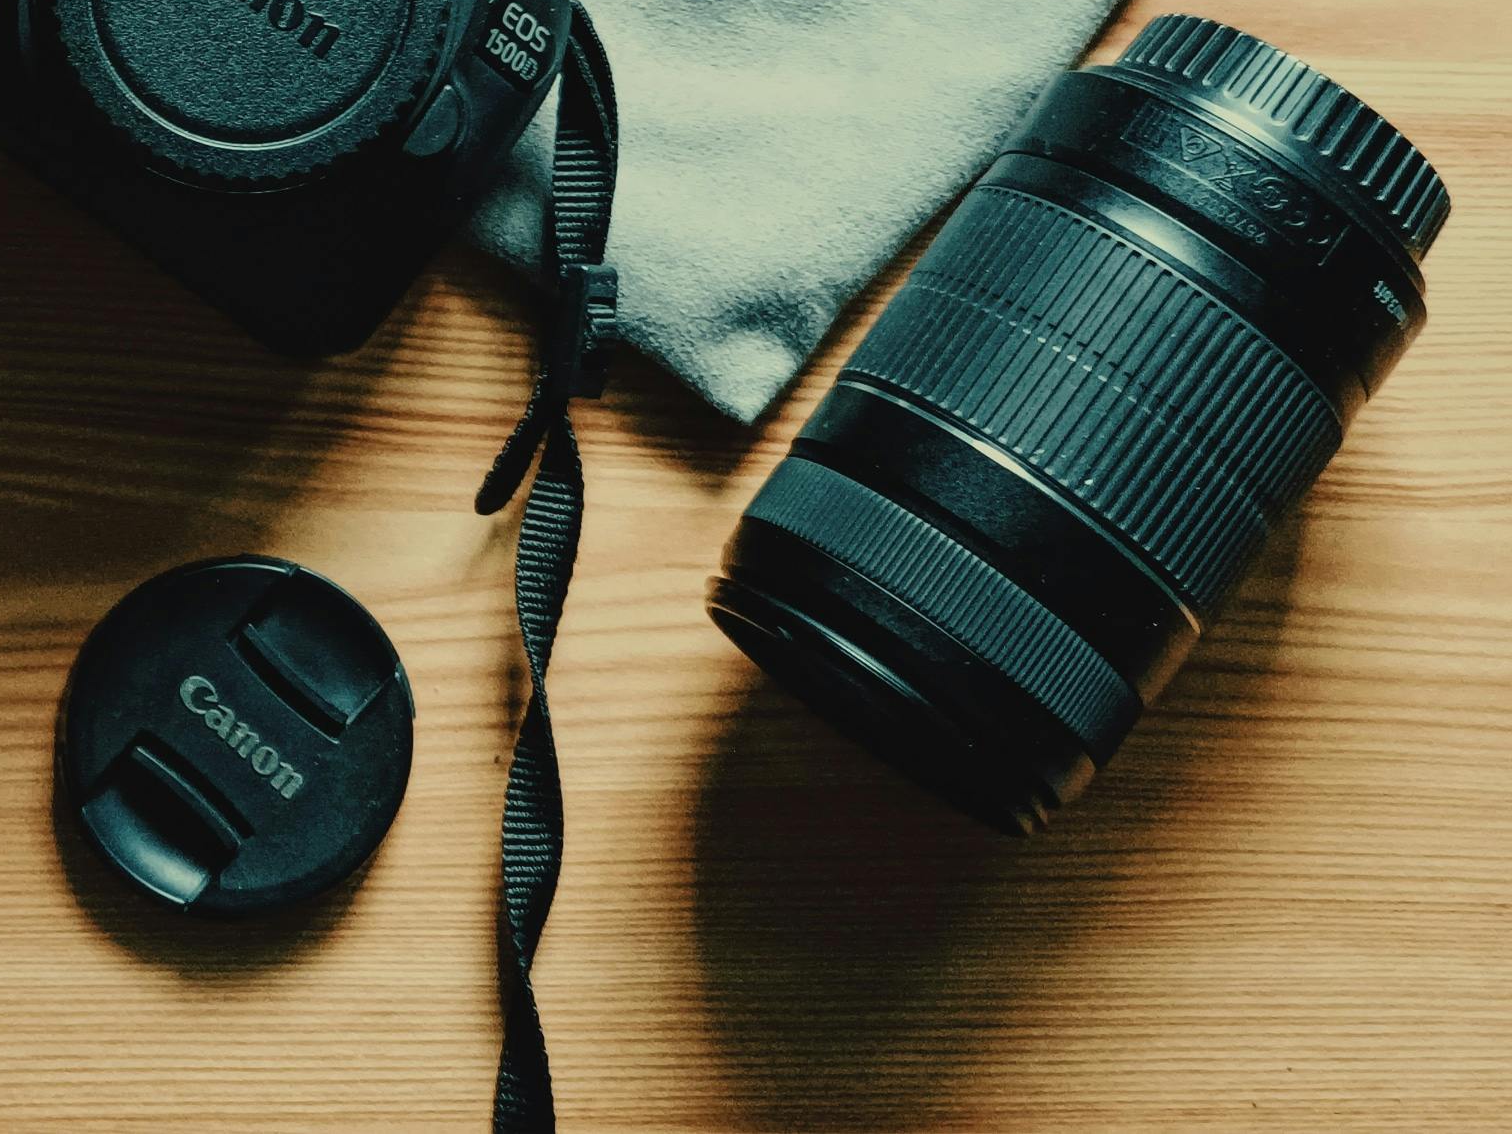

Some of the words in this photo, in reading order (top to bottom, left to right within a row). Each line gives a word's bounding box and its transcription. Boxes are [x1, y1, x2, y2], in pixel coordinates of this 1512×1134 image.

[502, 2, 551, 53] EOS
[485, 28, 538, 81] 1500D
[179, 675, 304, 800] Canon
